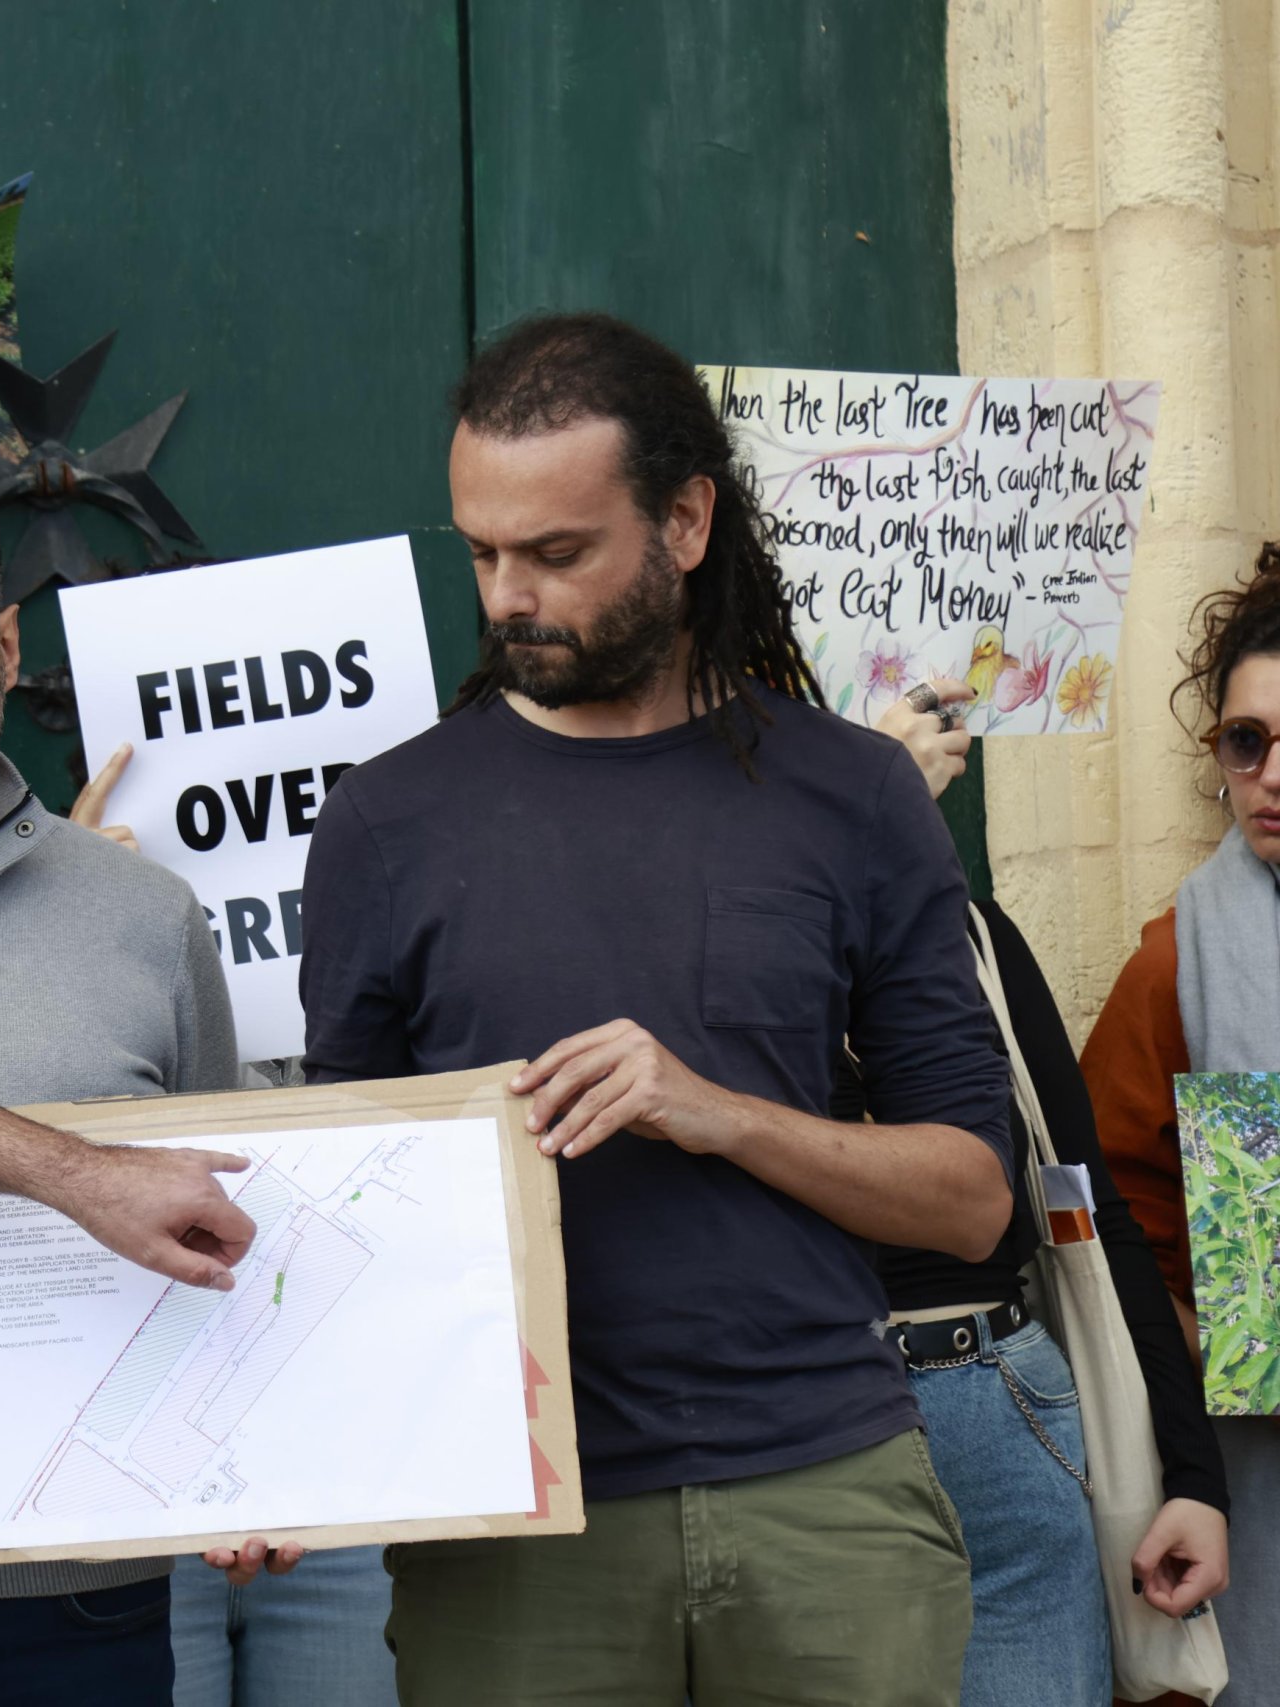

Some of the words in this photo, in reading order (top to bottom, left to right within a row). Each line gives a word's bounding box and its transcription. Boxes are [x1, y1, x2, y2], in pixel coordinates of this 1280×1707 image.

[719, 367, 764, 419] hen
[779, 379, 825, 435] the
[836, 378, 886, 438] last
[895, 375, 949, 429] Tree
[980, 389, 1021, 436] has
[1027, 383, 1066, 452] been
[1070, 388, 1110, 438] cut
[866, 459, 919, 502] last
[998, 450, 1069, 508] caught,
[1070, 457, 1100, 492] the
[1105, 448, 1146, 493] last
[880, 512, 935, 568] only
[937, 512, 996, 573] then
[997, 507, 1029, 562] will
[1034, 522, 1060, 551] we
[1065, 507, 1127, 556] realize
[136, 639, 375, 740] FIELDS
